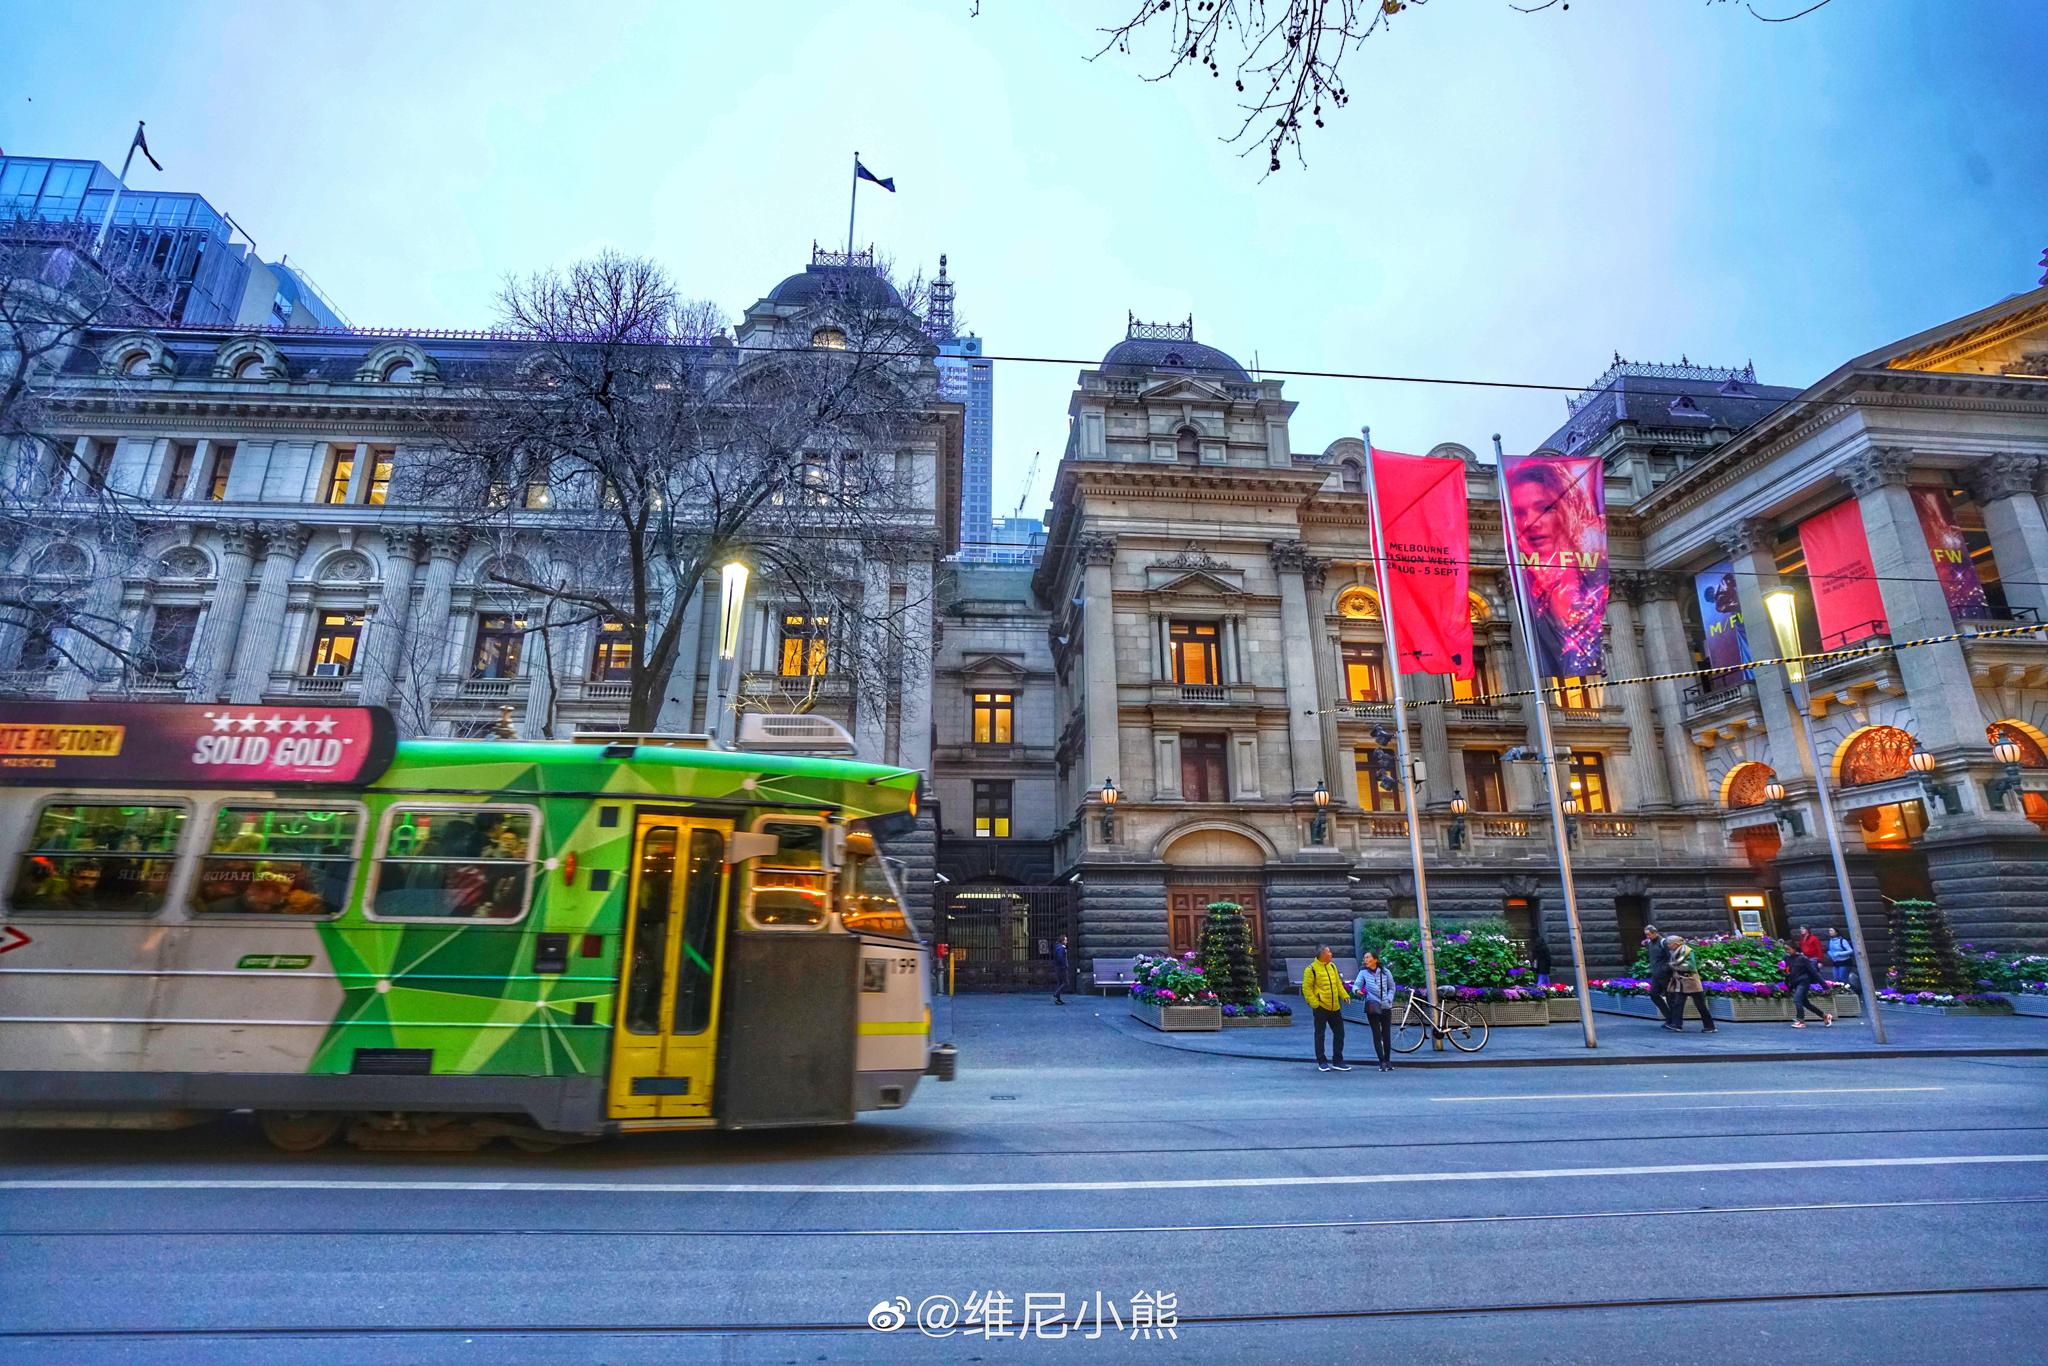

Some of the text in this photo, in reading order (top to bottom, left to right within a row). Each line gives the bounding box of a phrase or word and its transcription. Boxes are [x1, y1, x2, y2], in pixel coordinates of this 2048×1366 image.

[1389, 543, 1449, 554] MELBOURNE
[1429, 556, 1457, 565] WEEK
[1424, 566, 1431, 575] 5
[1434, 567, 1459, 576] SEPT
[32, 729, 118, 751] FACTORY
[192, 735, 270, 765] SOLID
[891, 958, 918, 974] 199
